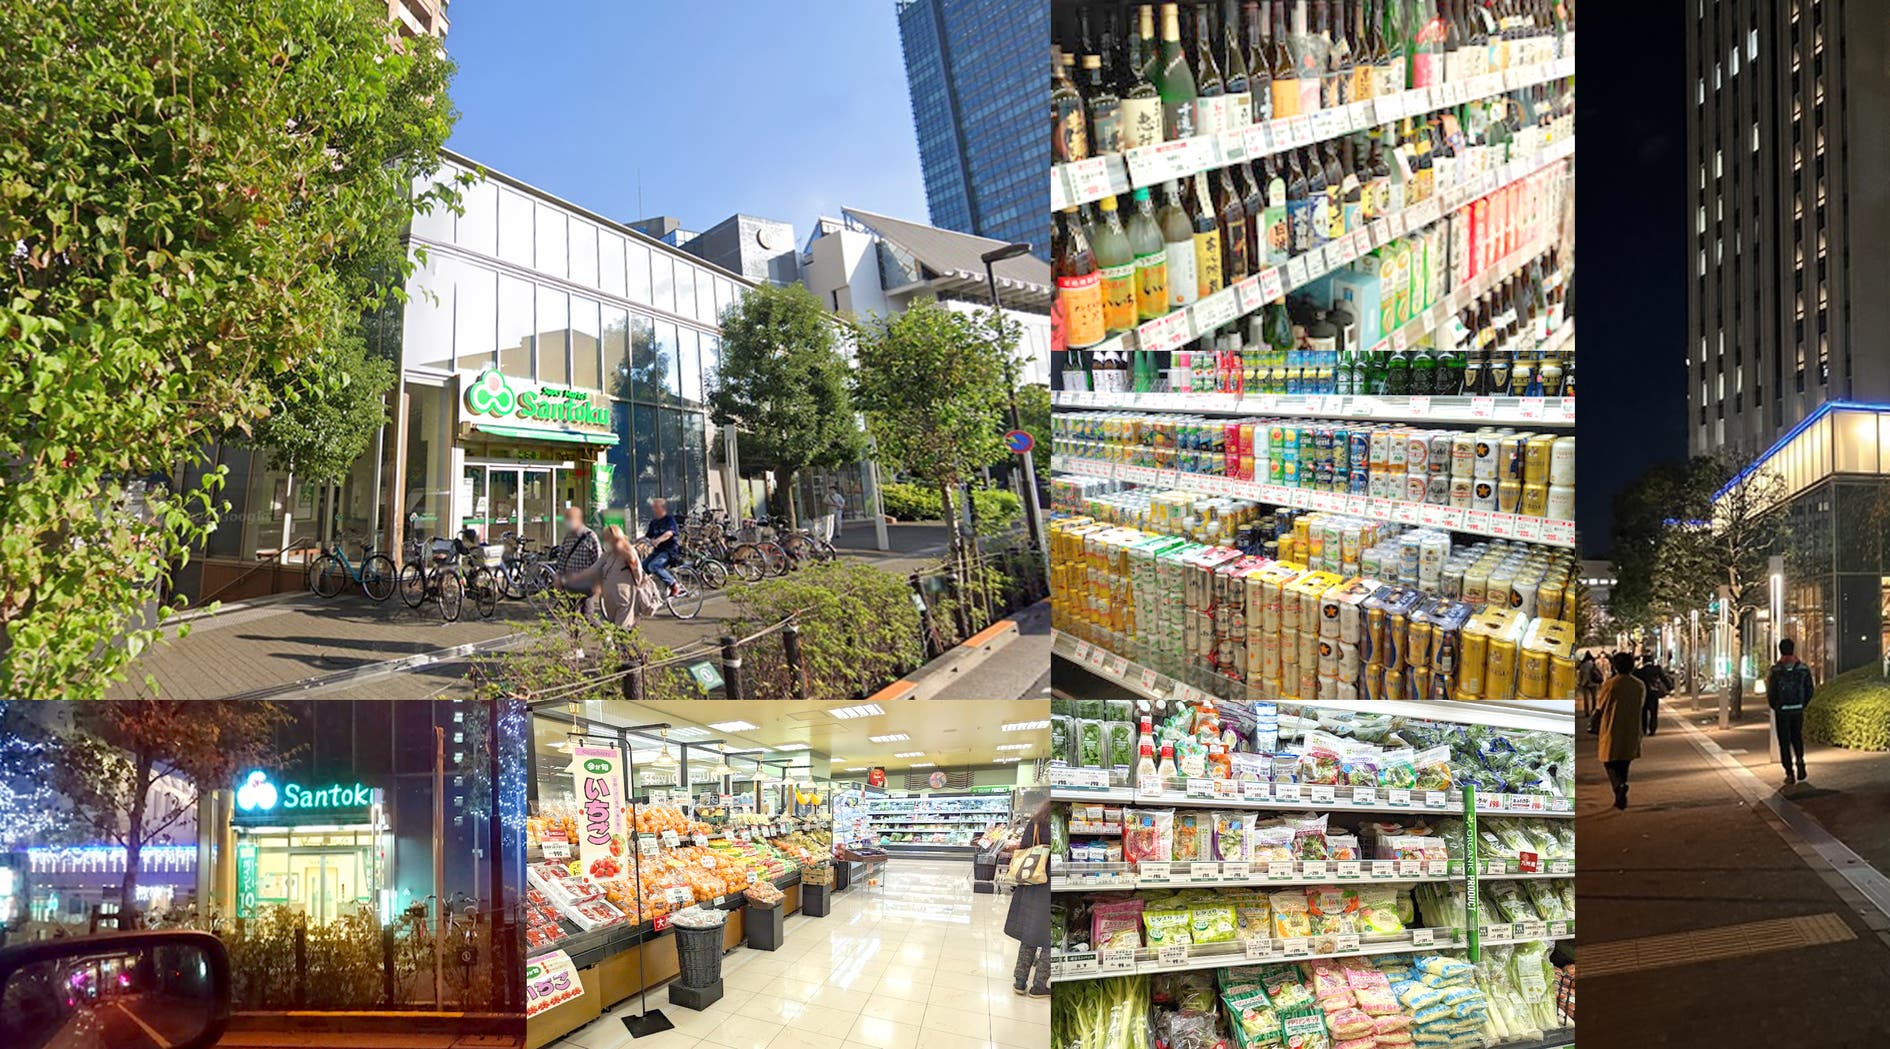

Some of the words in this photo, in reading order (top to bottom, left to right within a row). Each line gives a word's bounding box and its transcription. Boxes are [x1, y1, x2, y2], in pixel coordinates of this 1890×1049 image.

[518, 391, 609, 425] Santoku
[283, 783, 373, 808] Santok
[1467, 875, 1476, 911] PRODUCT
